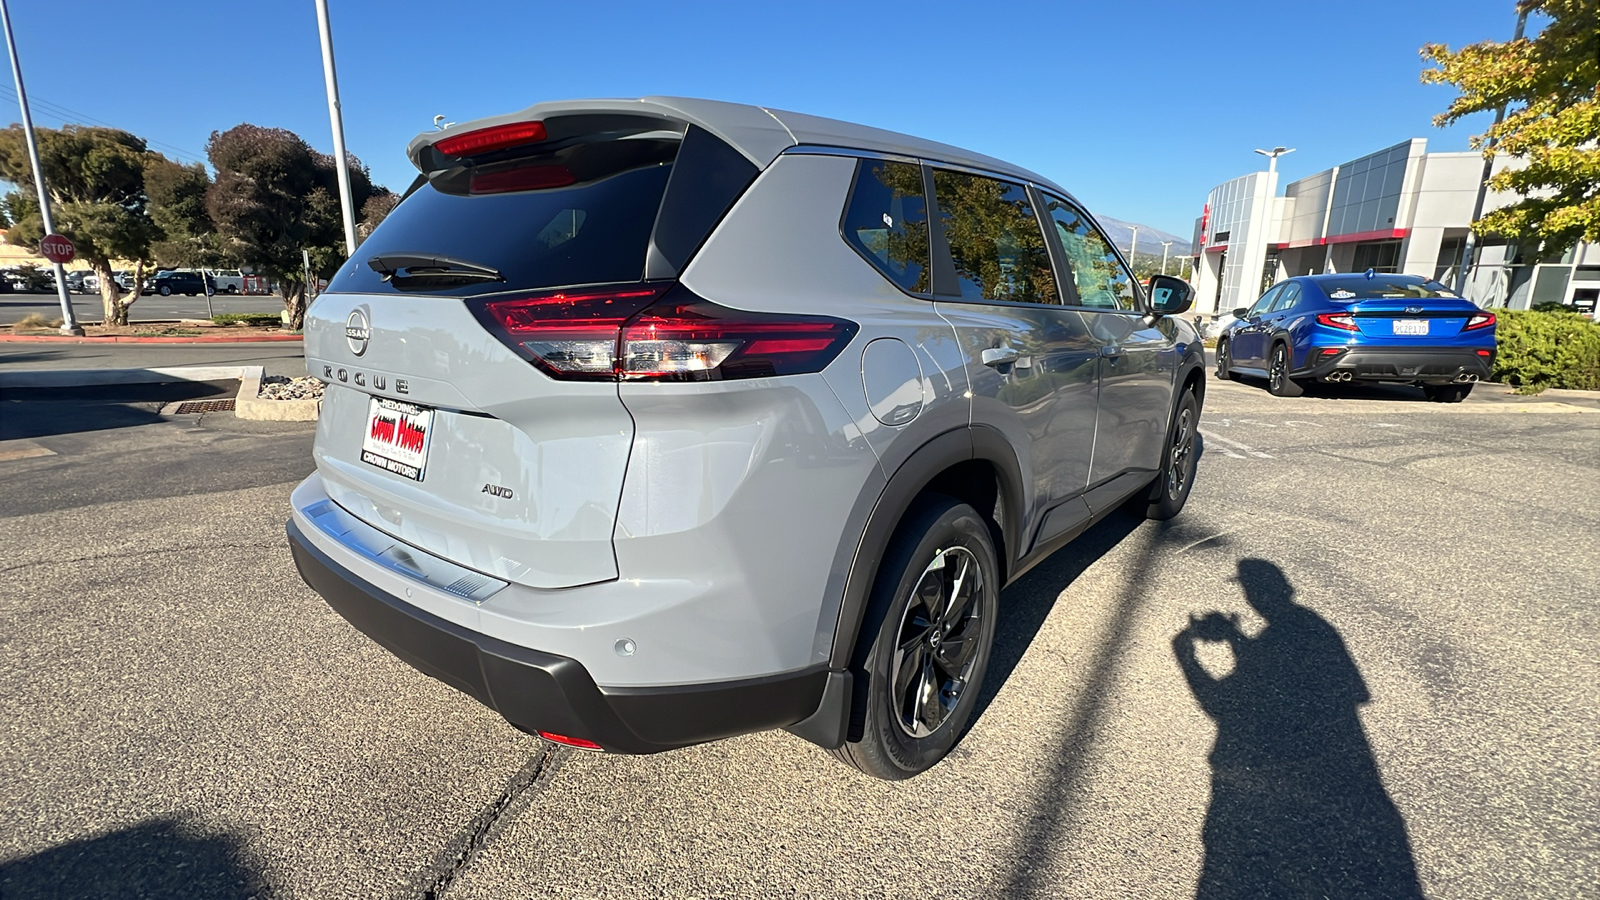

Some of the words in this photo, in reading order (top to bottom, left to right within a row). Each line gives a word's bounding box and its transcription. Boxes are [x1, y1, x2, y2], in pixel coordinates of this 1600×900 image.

[43, 243, 73, 256] STOP
[346, 328, 370, 339] SSAN
[323, 365, 409, 395] ROGUE
[382, 399, 416, 414] REDDING
[371, 413, 396, 445] Crown
[395, 413, 427, 454] Motors
[363, 451, 388, 468] CROWN
[387, 459, 417, 478] MOTORS
[481, 483, 514, 500] AWD
